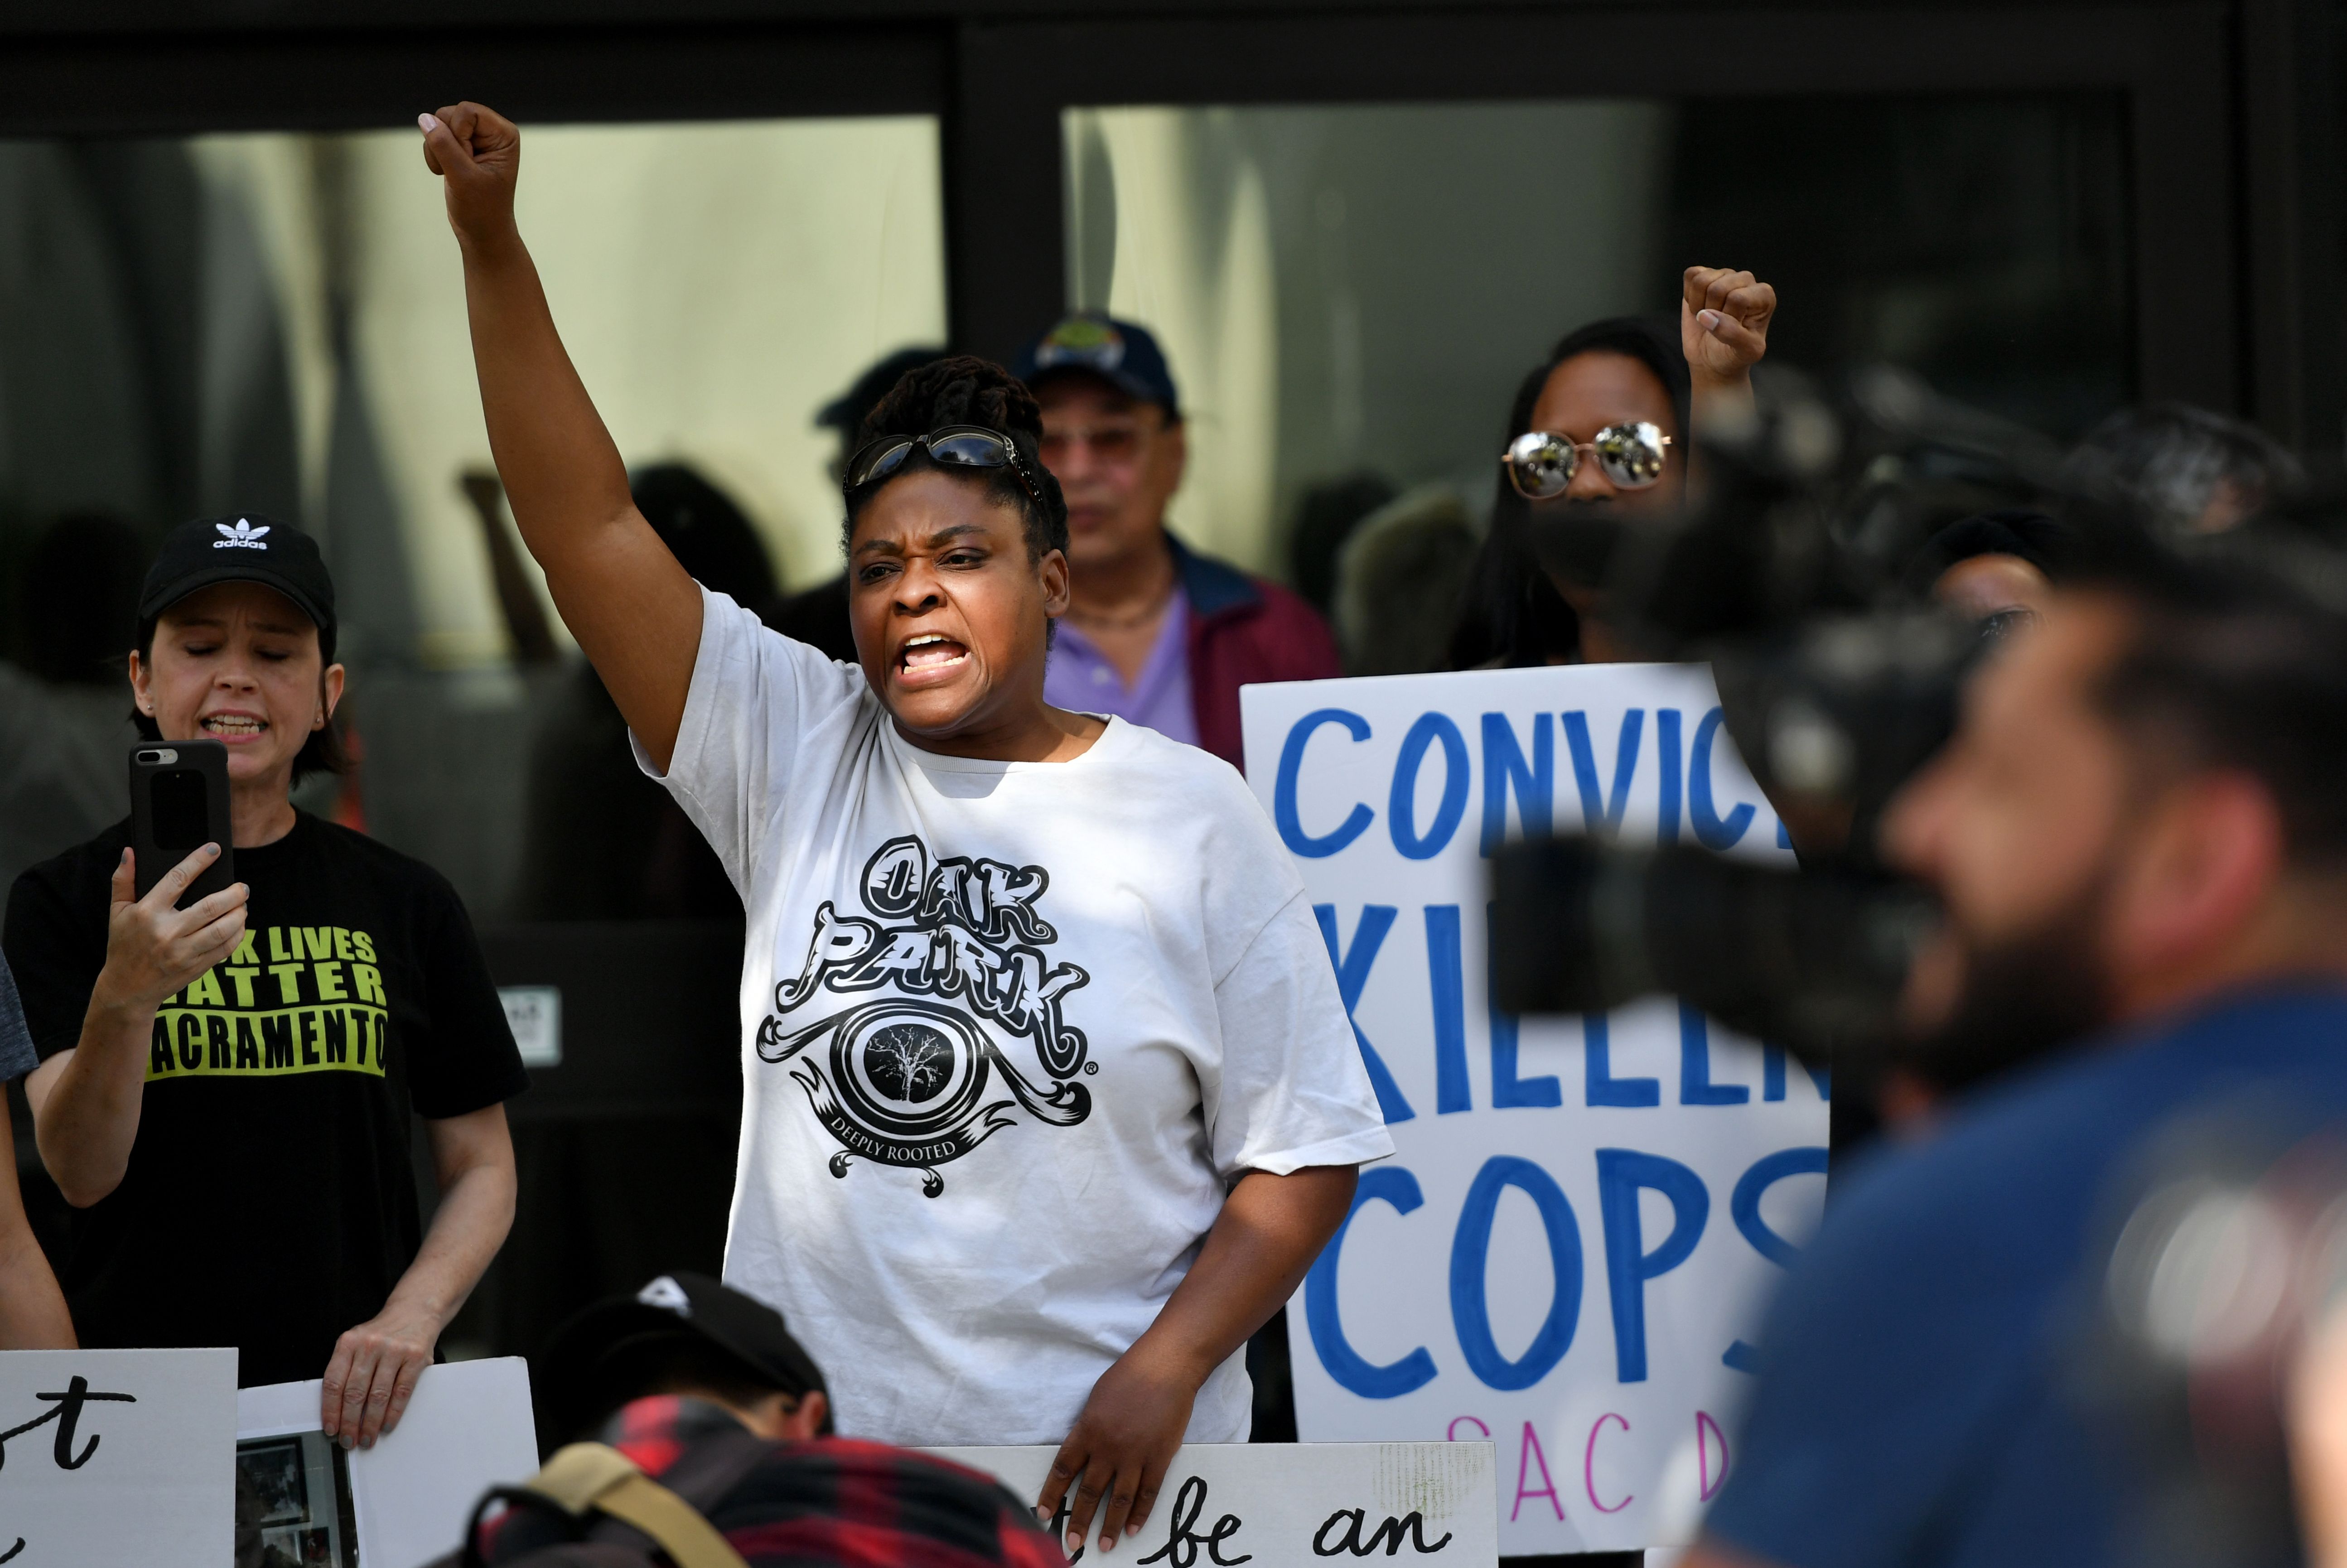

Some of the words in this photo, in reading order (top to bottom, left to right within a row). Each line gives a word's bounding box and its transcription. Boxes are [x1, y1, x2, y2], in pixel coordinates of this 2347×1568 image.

[213, 538, 267, 550] adidas
[1274, 706, 1794, 861] CONVIC
[860, 835, 1058, 945] OAK
[268, 926, 377, 963] LIVES
[162, 961, 387, 1007] ATTER
[776, 900, 1091, 1080] PARK
[151, 1008, 388, 1074] ACRAMENTO
[831, 1117, 885, 1156] DEEPLY
[887, 1141, 956, 1161] ROOTED
[1137, 1476, 1252, 1567] be
[1313, 1507, 1452, 1556] an
